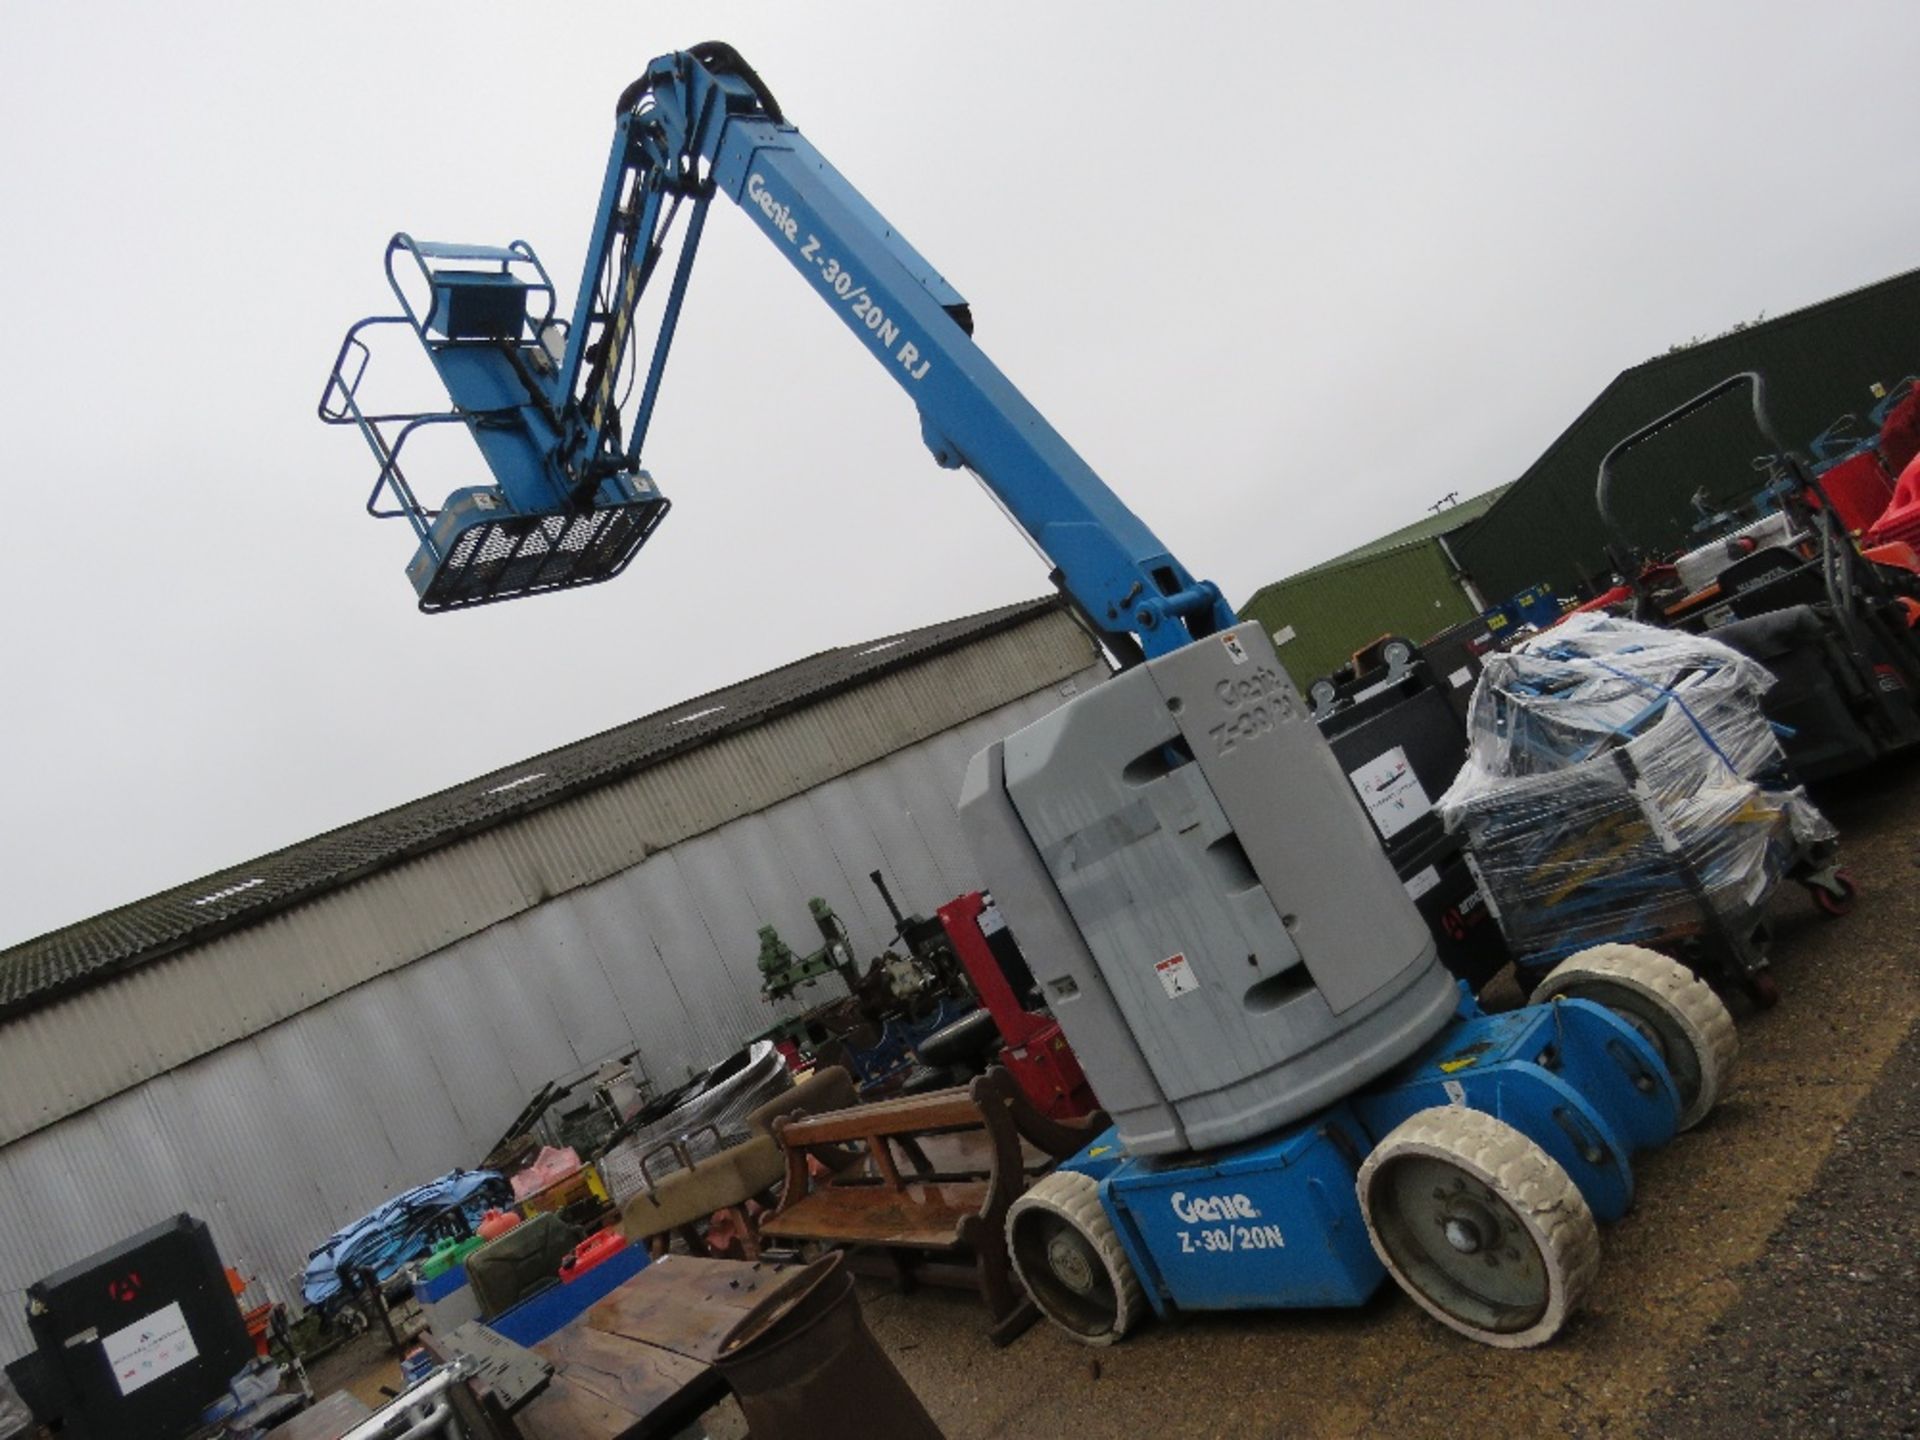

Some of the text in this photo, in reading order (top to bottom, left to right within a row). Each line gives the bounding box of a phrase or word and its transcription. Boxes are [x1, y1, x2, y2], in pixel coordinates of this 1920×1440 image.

[747, 173, 932, 381] Genie Z-30/20N RJ
[1170, 1191, 1256, 1224] Genie
[1176, 1224, 1285, 1253] Z-30/20N
